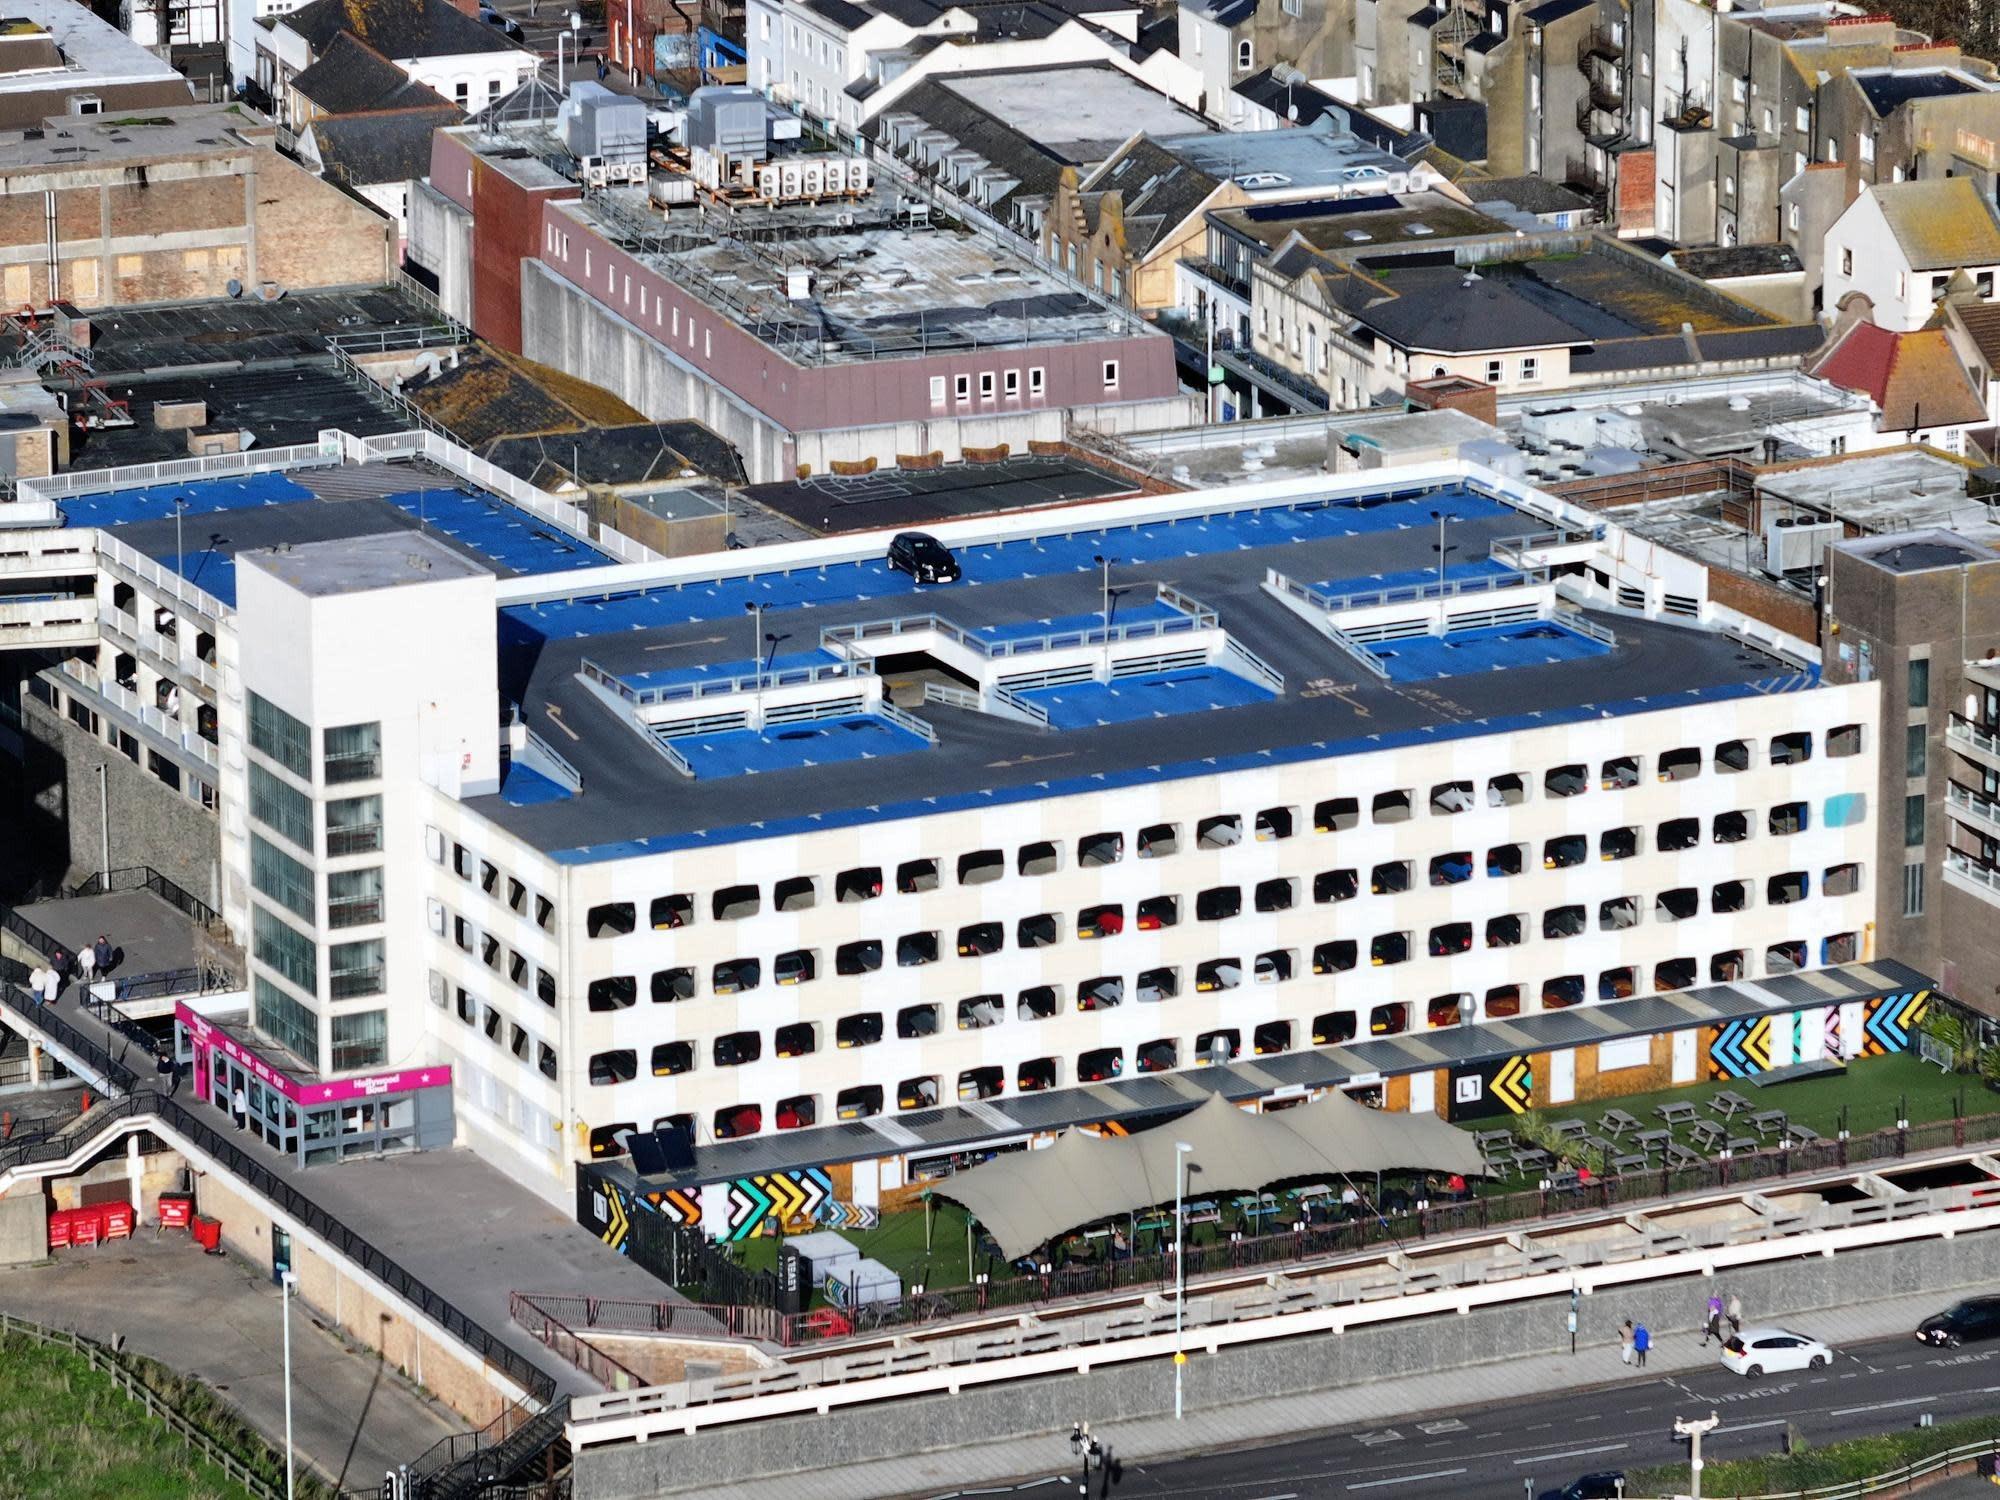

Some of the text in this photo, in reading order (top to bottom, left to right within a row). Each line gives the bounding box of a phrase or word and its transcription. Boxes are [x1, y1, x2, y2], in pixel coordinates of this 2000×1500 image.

[1306, 679, 1334, 689] NO
[353, 1073, 400, 1088] Hollywood
[365, 1083, 388, 1095] Bowl
